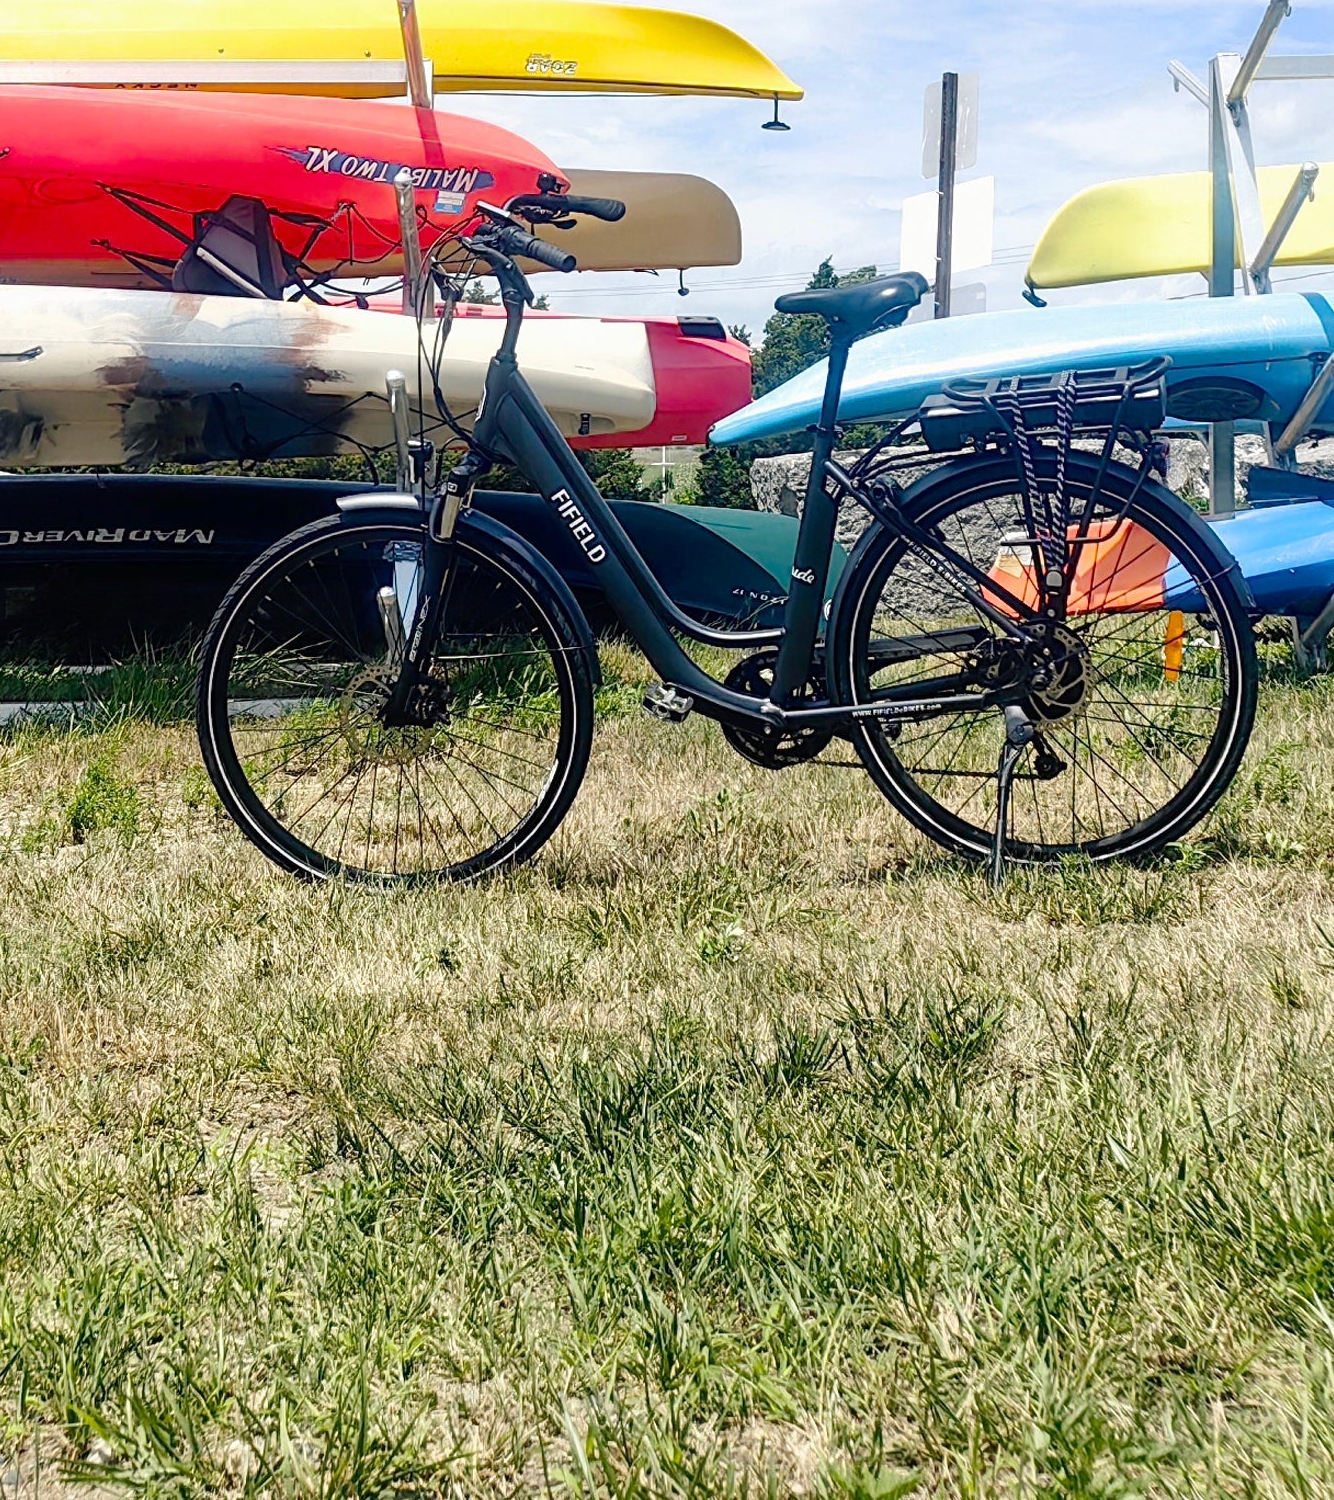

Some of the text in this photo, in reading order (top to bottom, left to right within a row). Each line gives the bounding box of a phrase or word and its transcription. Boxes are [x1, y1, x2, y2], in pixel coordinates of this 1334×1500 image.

[304, 146, 339, 173] XL
[340, 155, 388, 182] TWO
[550, 488, 606, 563] FIFIELD
